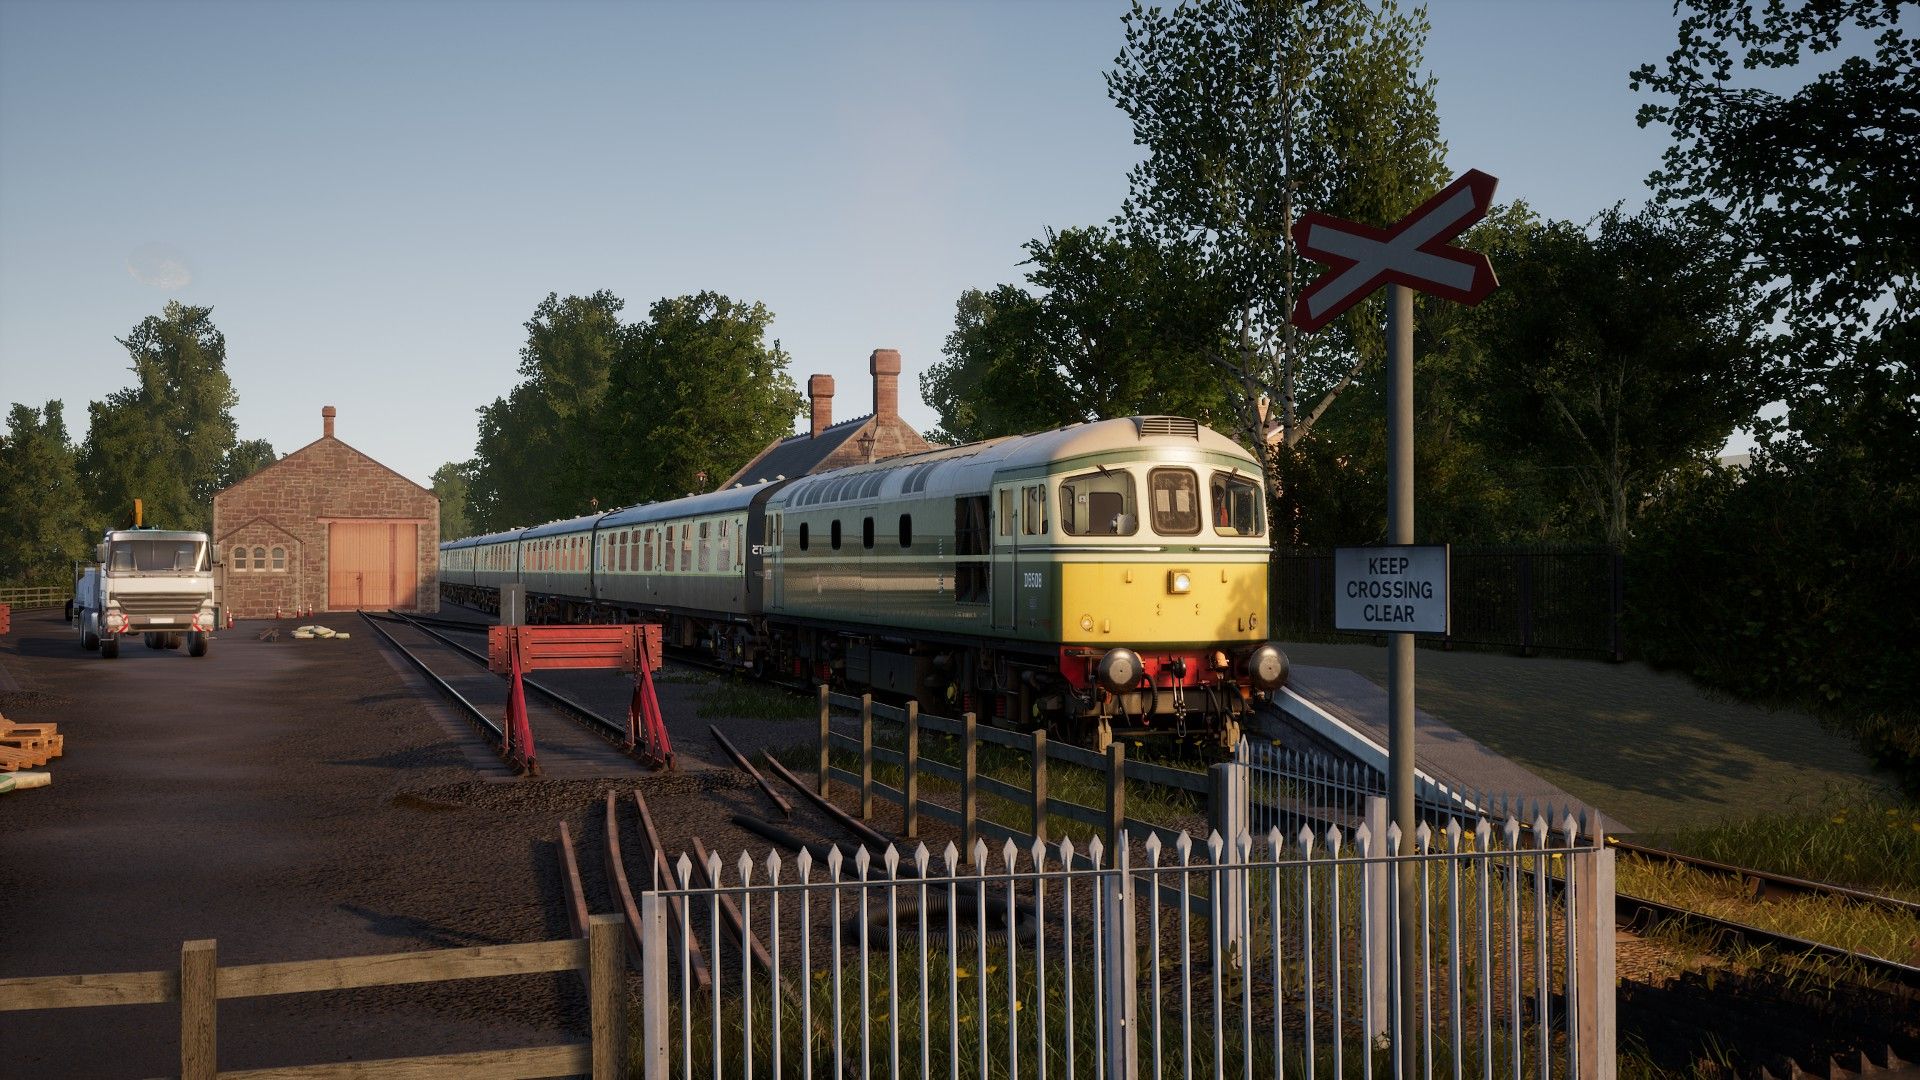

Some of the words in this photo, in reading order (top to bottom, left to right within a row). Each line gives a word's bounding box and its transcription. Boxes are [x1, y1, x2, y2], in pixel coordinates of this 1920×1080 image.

[1368, 557, 1409, 575] KEEP
[1346, 580, 1433, 599] CROSSING
[1363, 604, 1415, 622] CLEAR
